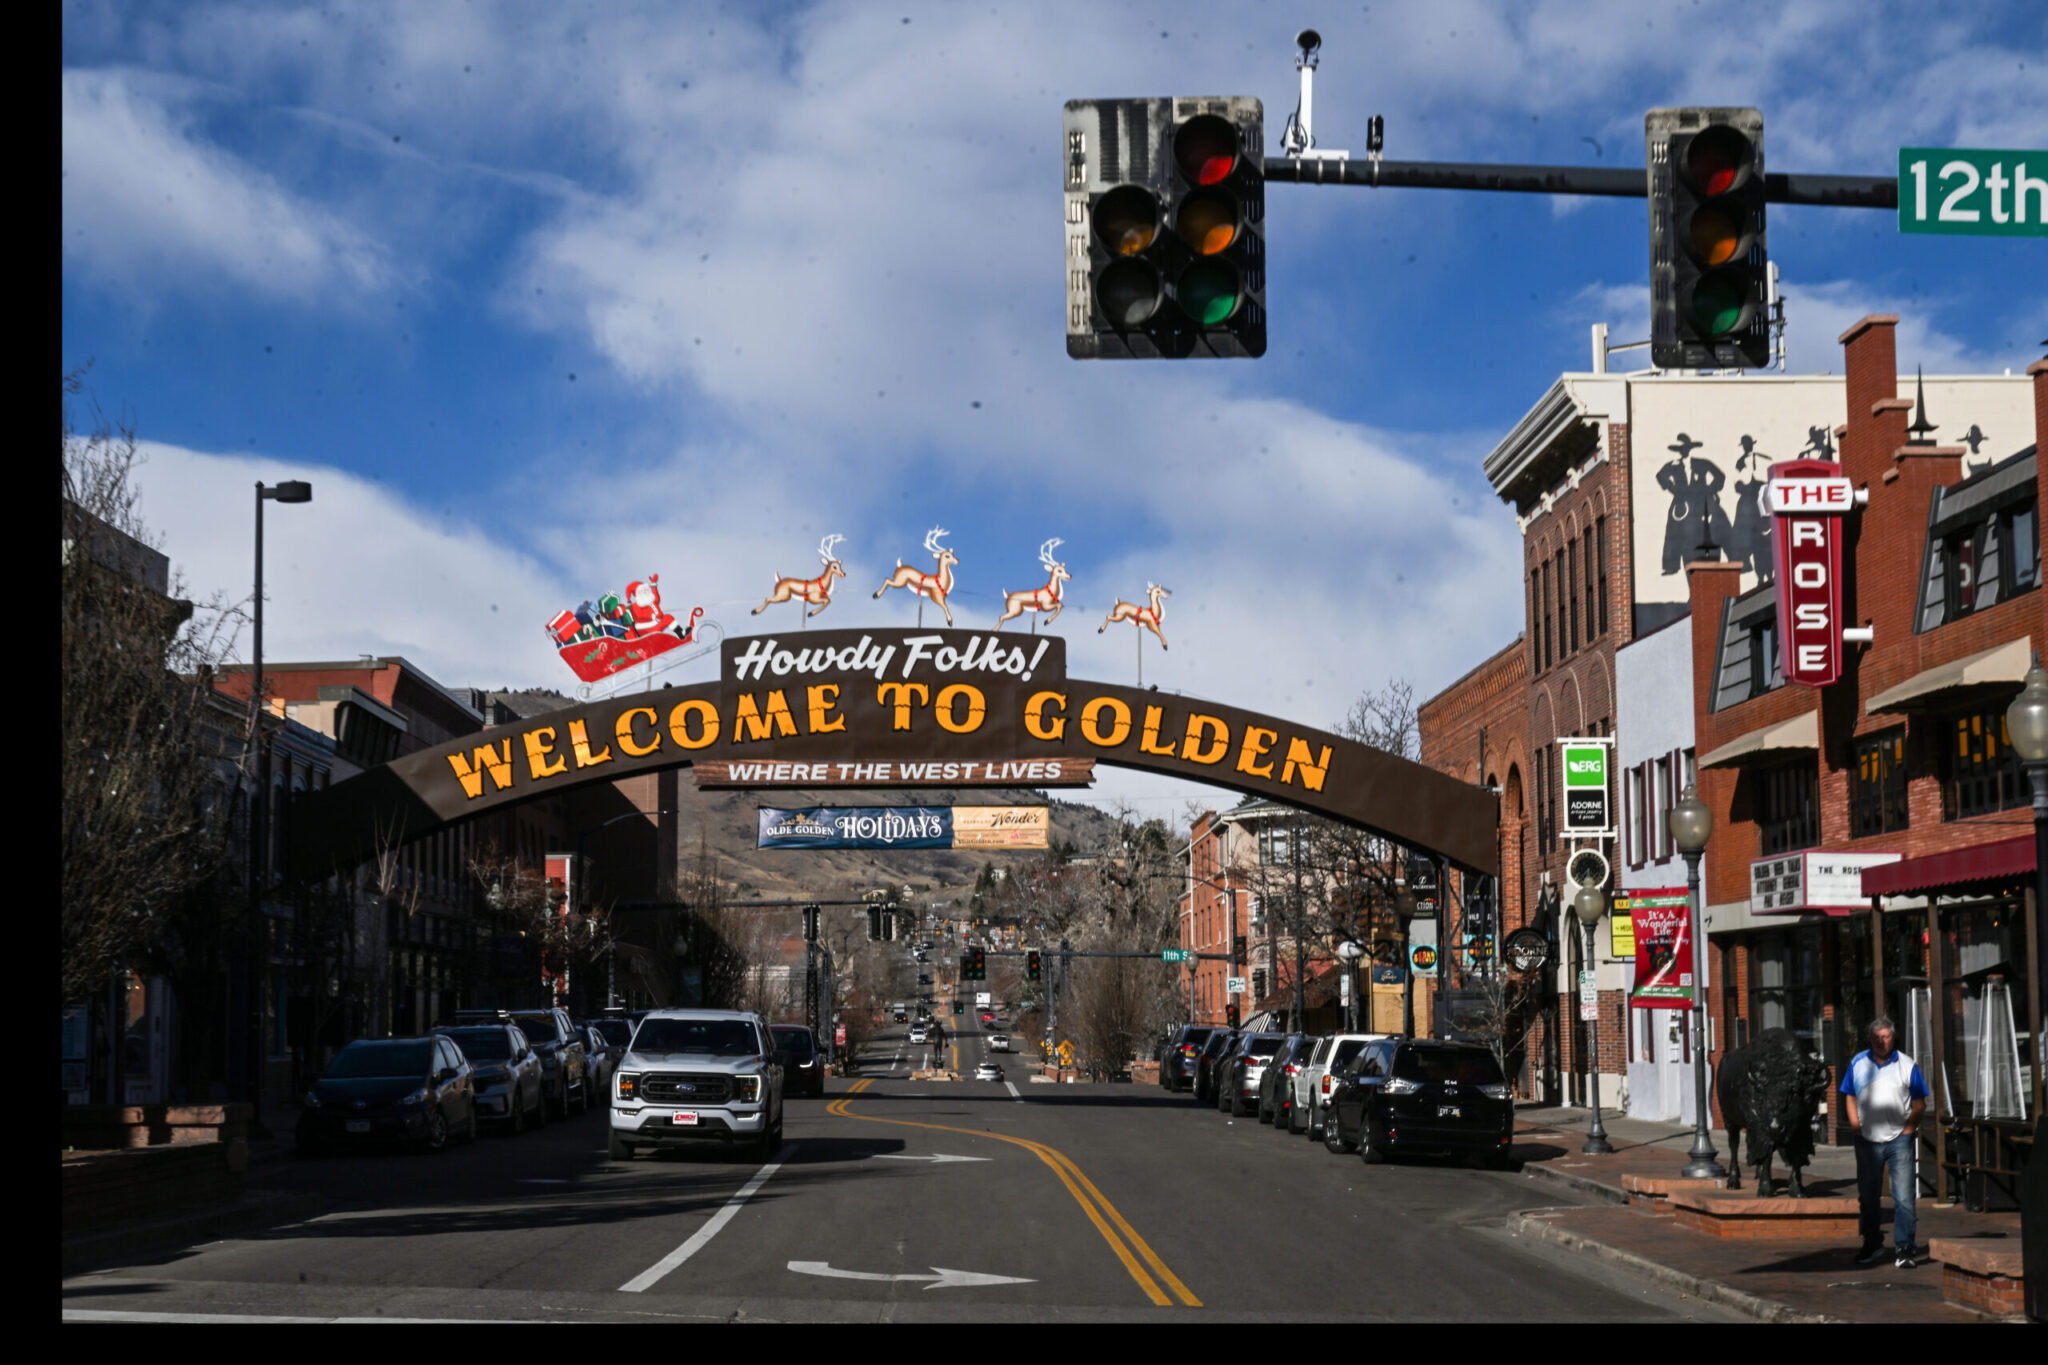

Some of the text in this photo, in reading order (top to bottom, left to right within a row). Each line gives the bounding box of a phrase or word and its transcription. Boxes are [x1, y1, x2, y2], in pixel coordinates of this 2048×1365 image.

[1910, 160, 2048, 224] 12th
[1776, 485, 1846, 505] THE
[1793, 521, 1829, 671] ROSE
[734, 634, 1050, 682] Howdy Folks!
[447, 683, 1335, 799] WELCOME TO GOLDEN
[728, 762, 1062, 781] WHERE THE WEST LIVES
[1579, 760, 1602, 772] ERG
[1571, 801, 1602, 810] ADORNE
[766, 825, 792, 836] OLDE
[795, 825, 835, 836] GOLDEN
[1818, 866, 1833, 874] THE
[1648, 910, 1676, 920] It's A
[1637, 917, 1688, 930] Wonderful
[1163, 950, 1180, 961] 11th
